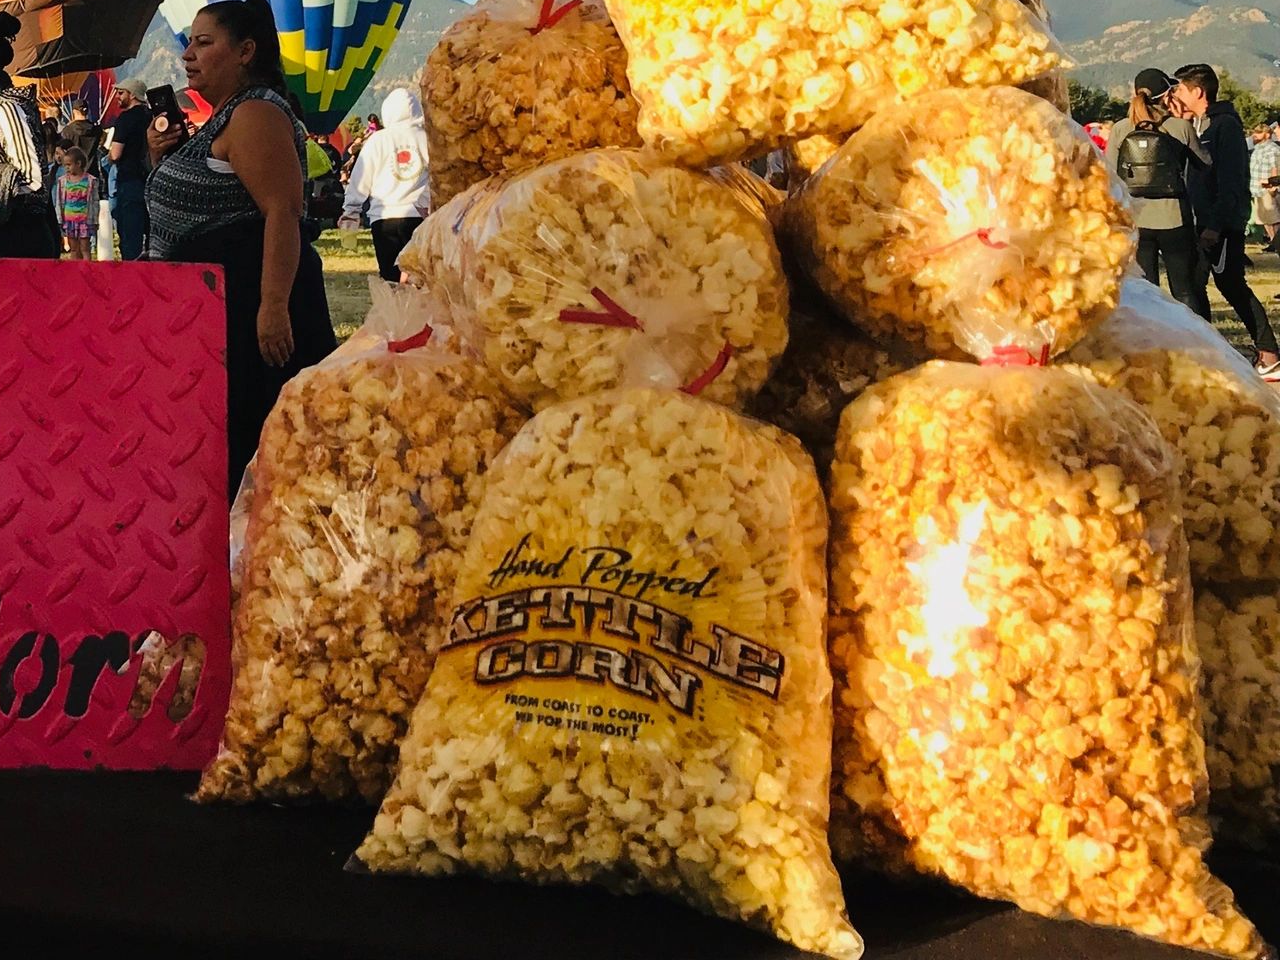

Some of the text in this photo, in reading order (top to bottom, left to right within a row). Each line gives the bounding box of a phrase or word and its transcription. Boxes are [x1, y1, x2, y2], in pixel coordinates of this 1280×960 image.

[487, 531, 575, 589] Hand
[439, 583, 786, 701] KETTLE
[473, 639, 704, 718] CORN
[505, 693, 656, 725] FROM COAST TO COAST,
[516, 711, 534, 722] WE
[537, 714, 563, 727] POP
[567, 719, 588, 731] THE
